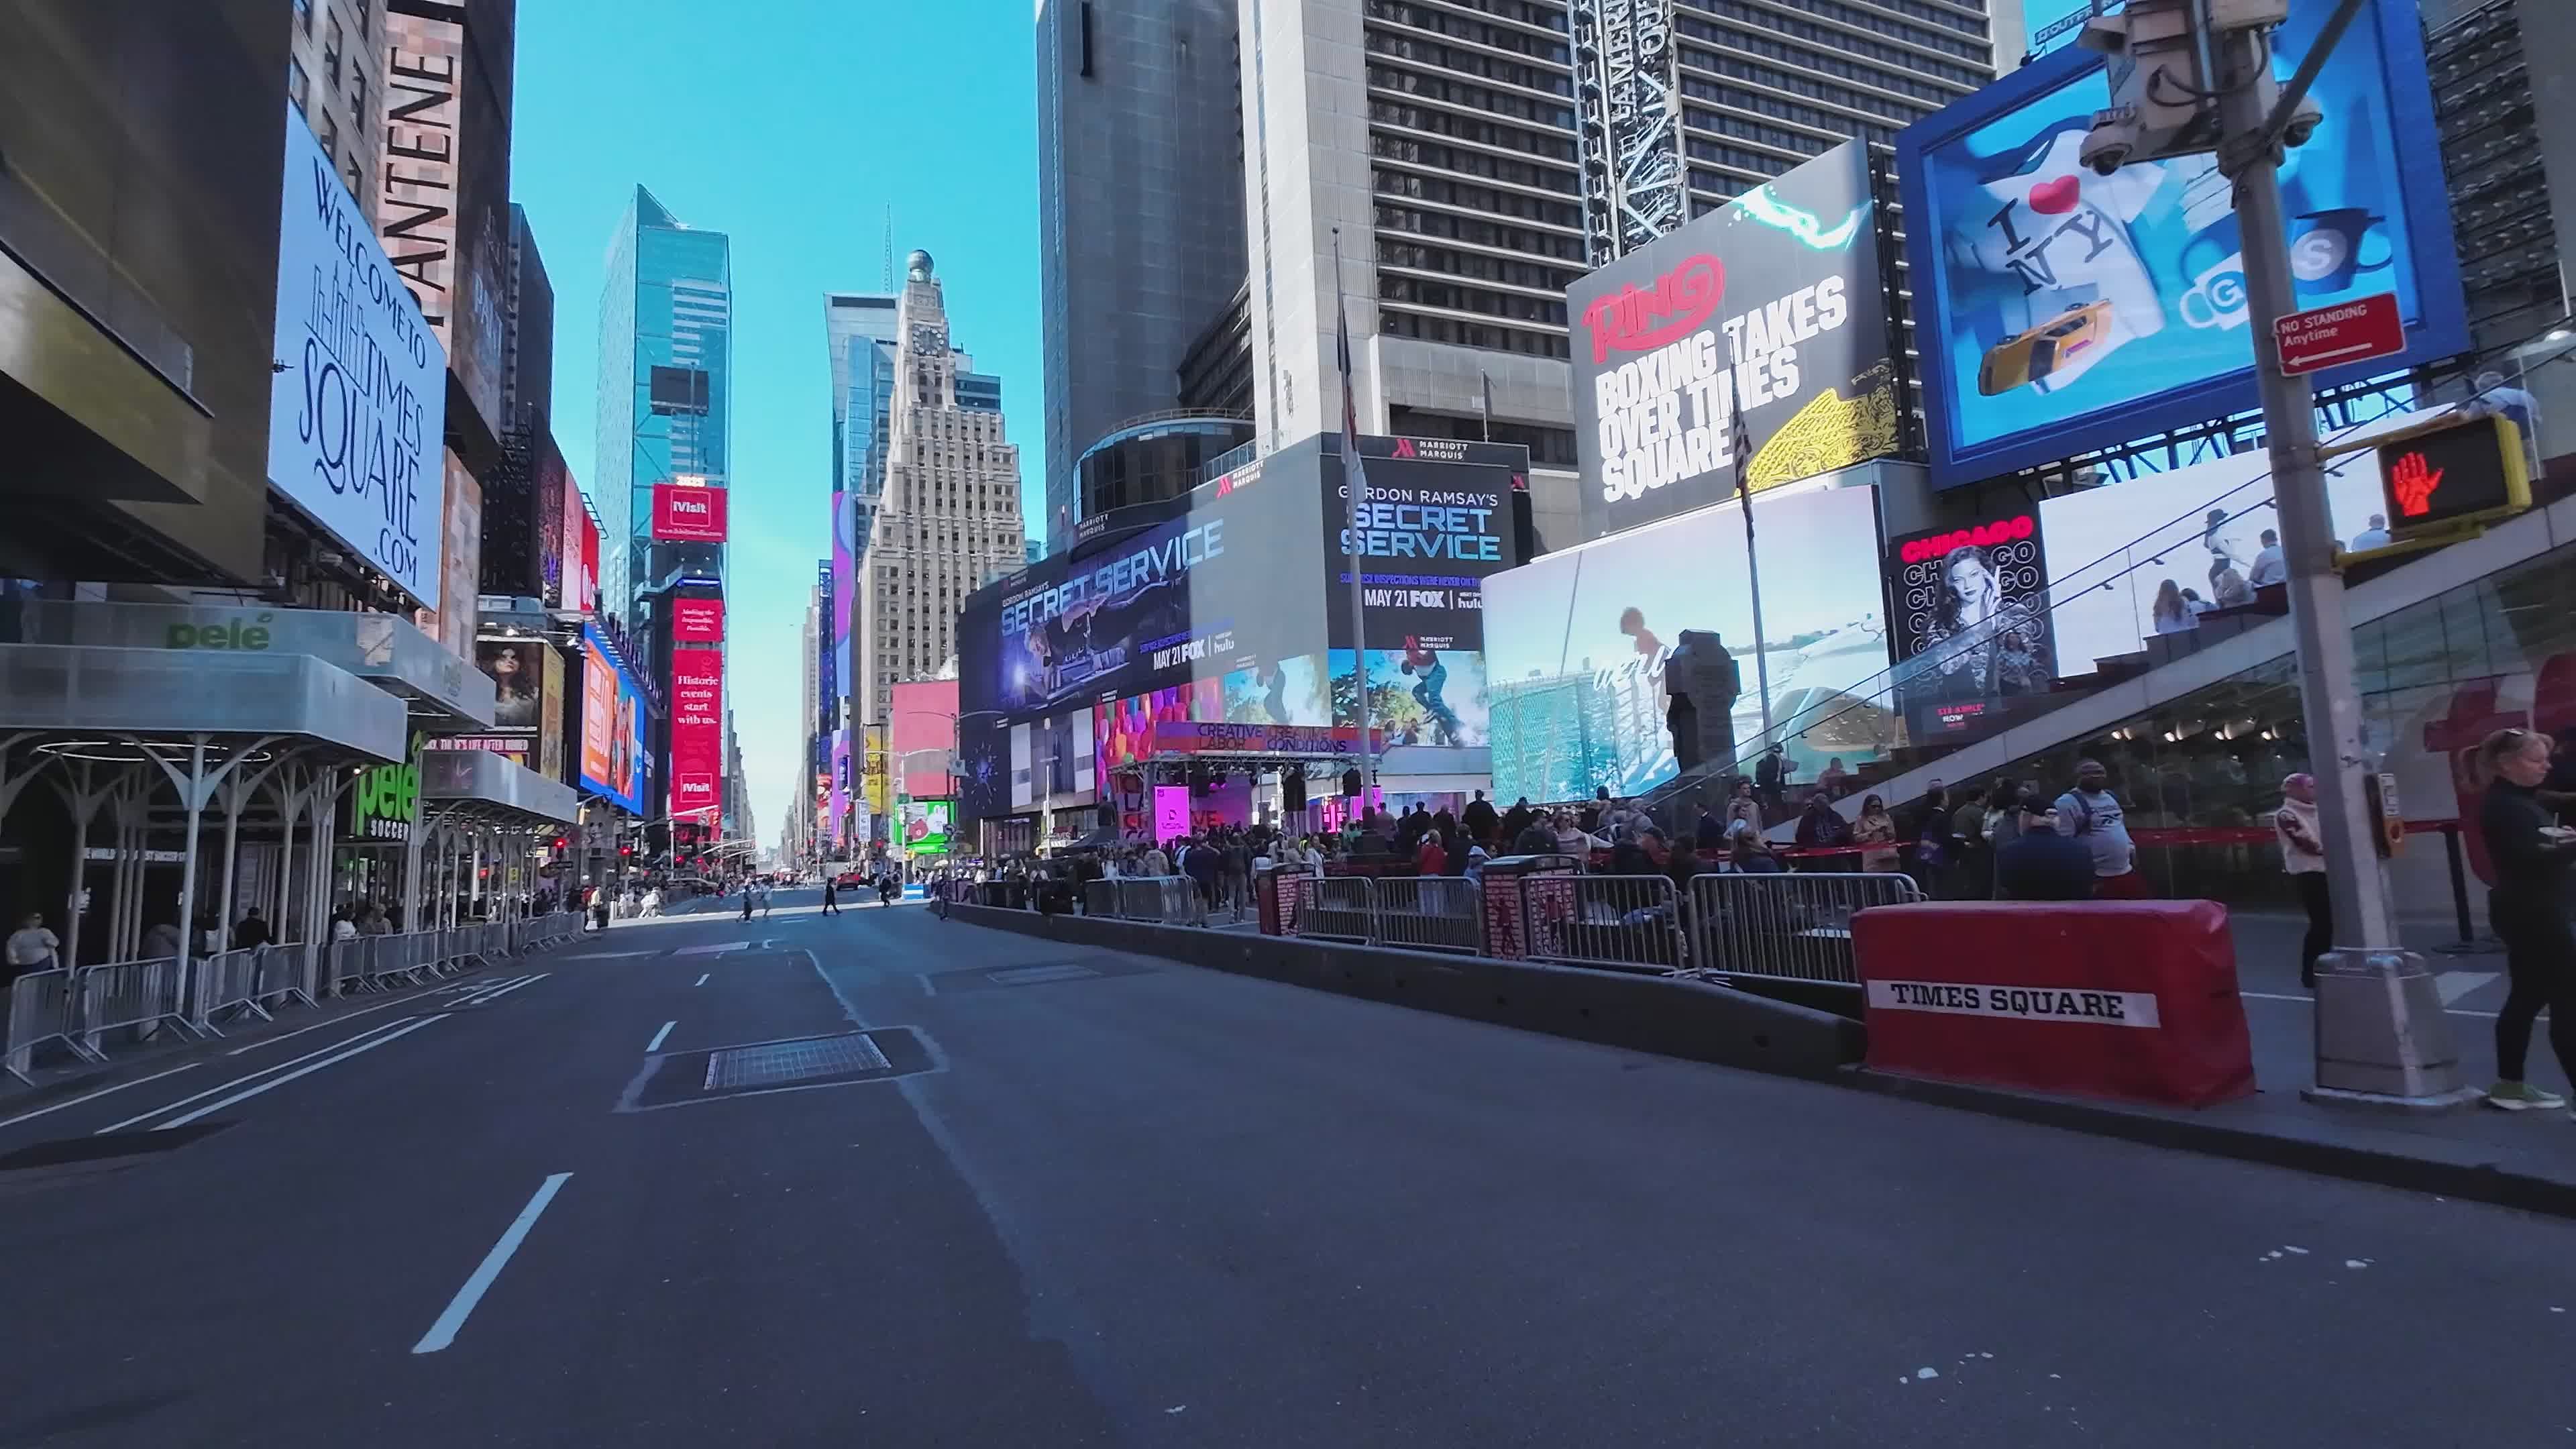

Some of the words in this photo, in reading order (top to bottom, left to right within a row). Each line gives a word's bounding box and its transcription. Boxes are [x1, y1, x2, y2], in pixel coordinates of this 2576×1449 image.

[1988, 197, 2031, 255] I
[313, 155, 406, 341] WELCOME
[408, 318, 425, 370] TO
[2006, 210, 2114, 296] NY
[2300, 231, 2334, 271] S
[2212, 279, 2244, 307] G
[2281, 321, 2300, 334] NO
[2304, 304, 2367, 329] STANDING
[1596, 330, 1717, 419] BOXING
[1722, 275, 1847, 366] TAKES
[2284, 327, 2339, 347] Anytime
[364, 333, 423, 456] TIMES
[1599, 390, 1682, 460] OVER
[1686, 345, 1800, 428] TIMES
[299, 337, 420, 546] SQUARE
[1419, 441, 1468, 451] MARRIOTT
[1419, 450, 1464, 460] MARQUIS
[1602, 419, 1733, 502] SQUARE
[1233, 472, 1261, 488] MARQUIS
[1338, 485, 1413, 502] GRDON
[1420, 492, 1499, 507] RAMSAY'S
[1346, 502, 1493, 533] SECRET
[1340, 529, 1502, 561] SERVICE
[1900, 515, 2034, 564] CHICAGO
[374, 527, 417, 587] .COM
[1002, 574, 1091, 637] SECRET
[1095, 519, 1224, 597] SERVICE
[1364, 589, 1392, 607] MAY
[1395, 590, 1408, 607] 21
[1410, 590, 1445, 608] FOX
[1153, 649, 1171, 670] MAY
[1171, 646, 1181, 665] 21
[1181, 639, 1205, 662] FOX
[1214, 638, 1234, 653] hulu
[678, 675, 718, 686] Historic
[681, 690, 712, 698] events
[678, 714, 701, 724] with
[684, 703, 709, 711] start
[1197, 722, 1263, 738] CREATIVE
[1198, 737, 1246, 751] LABOR
[1267, 739, 1347, 752] CONDITIONS
[370, 819, 409, 841] SOCCER
[1890, 983, 1981, 1009] TIMES
[1990, 989, 2126, 1019] SQUARE
